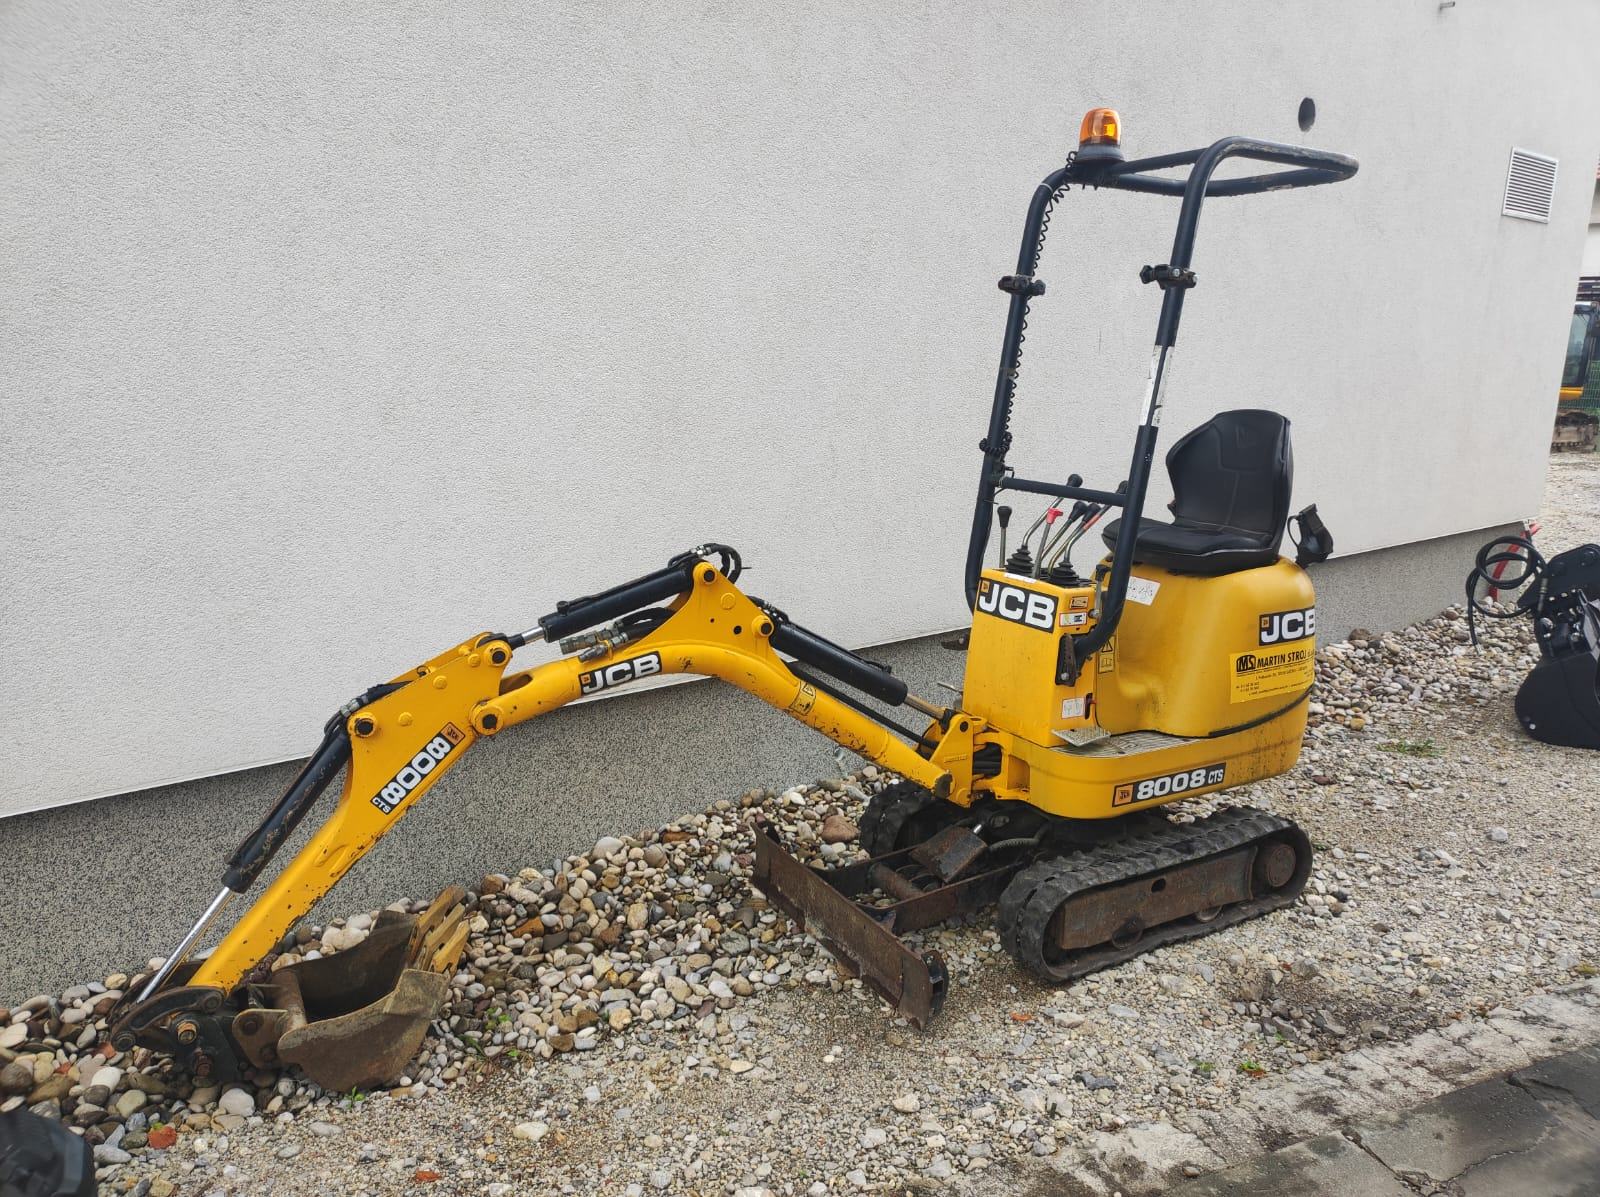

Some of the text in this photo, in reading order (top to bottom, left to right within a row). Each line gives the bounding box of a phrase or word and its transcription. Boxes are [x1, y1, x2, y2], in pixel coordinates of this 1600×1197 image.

[979, 583, 1055, 629] JCB
[583, 654, 660, 693] JCB
[1257, 653, 1286, 668] MARTIN
[1288, 650, 1307, 662] STROJ
[372, 736, 451, 814] 8008 CTS
[1136, 768, 1224, 800] 8008 CTS
